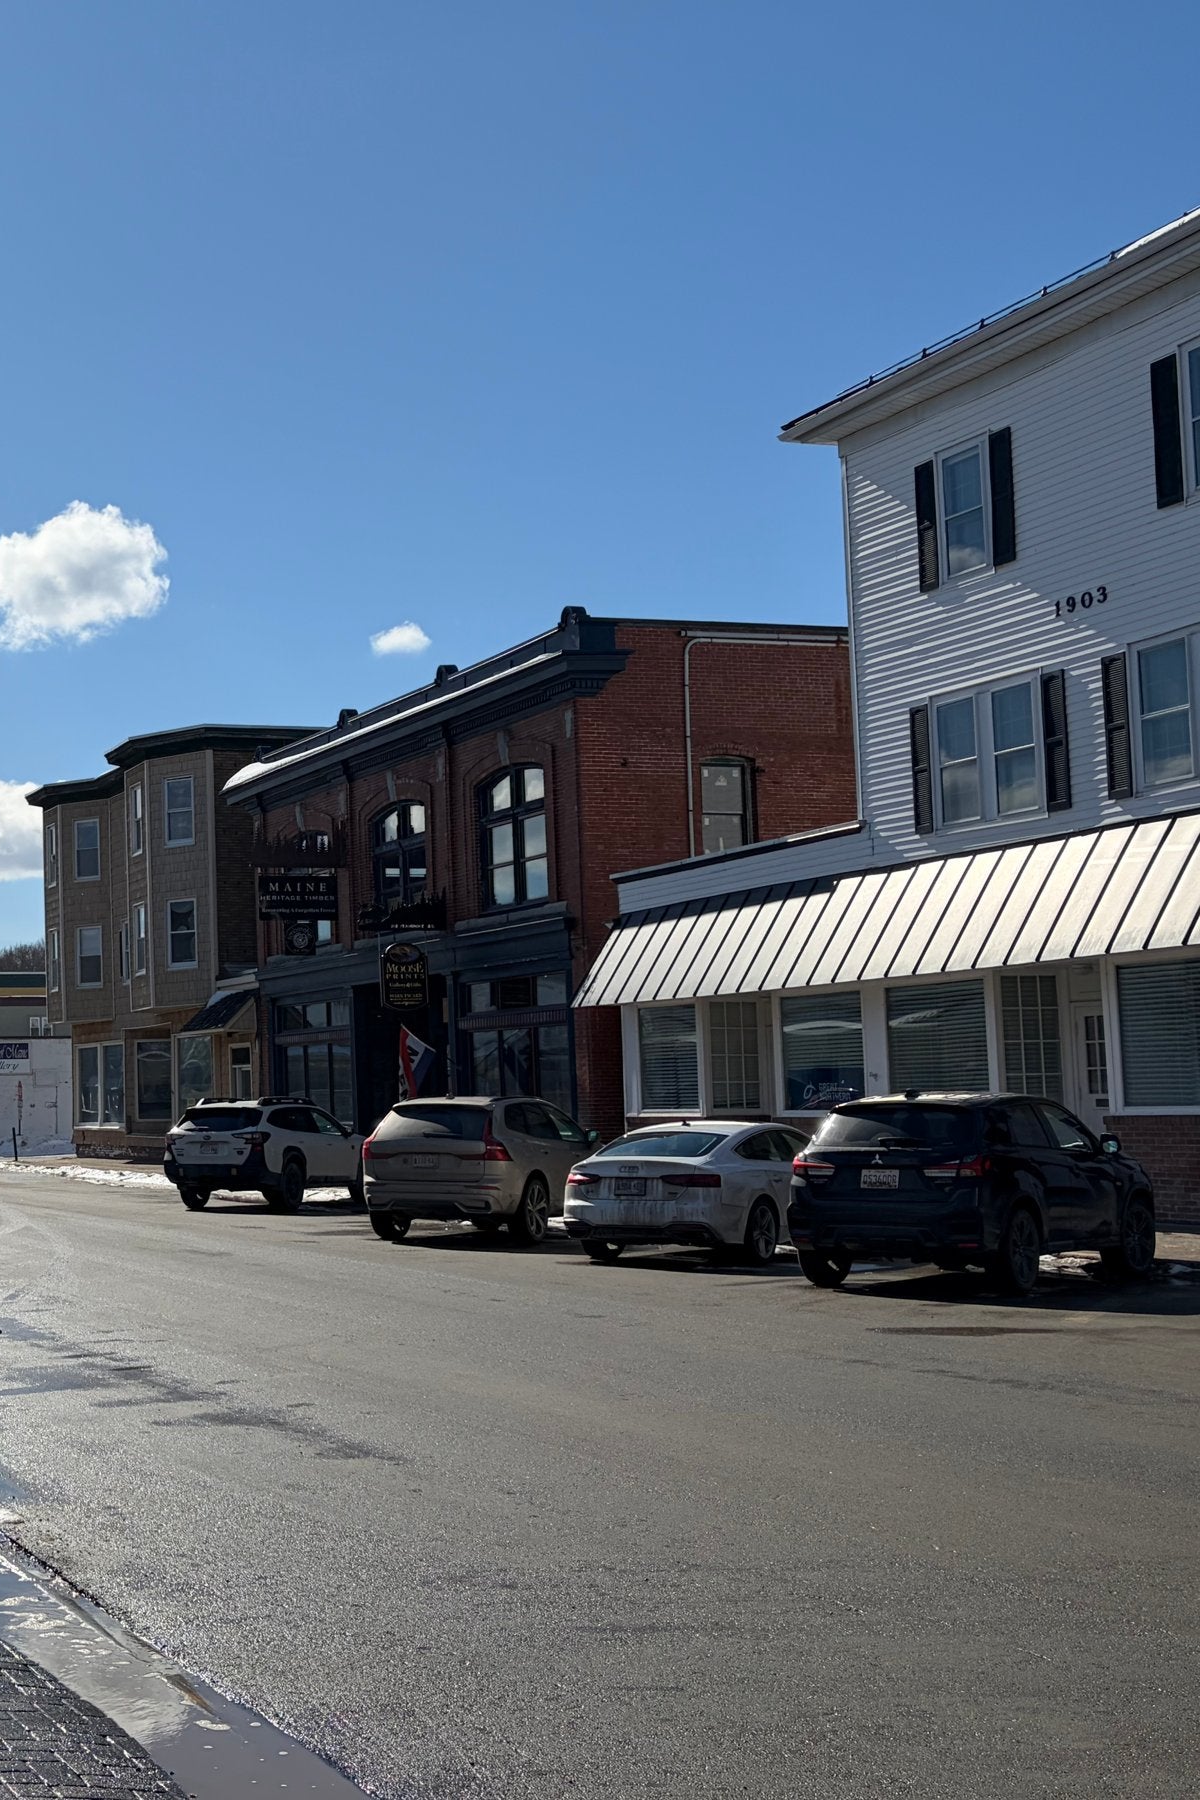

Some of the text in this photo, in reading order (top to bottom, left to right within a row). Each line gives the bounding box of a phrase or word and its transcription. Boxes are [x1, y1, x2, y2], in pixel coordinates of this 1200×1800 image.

[1054, 586, 1108, 617] 1903
[268, 882, 328, 892] MAINE
[0, 1045, 6, 1058] of
[6, 1044, 28, 1058] Maine
